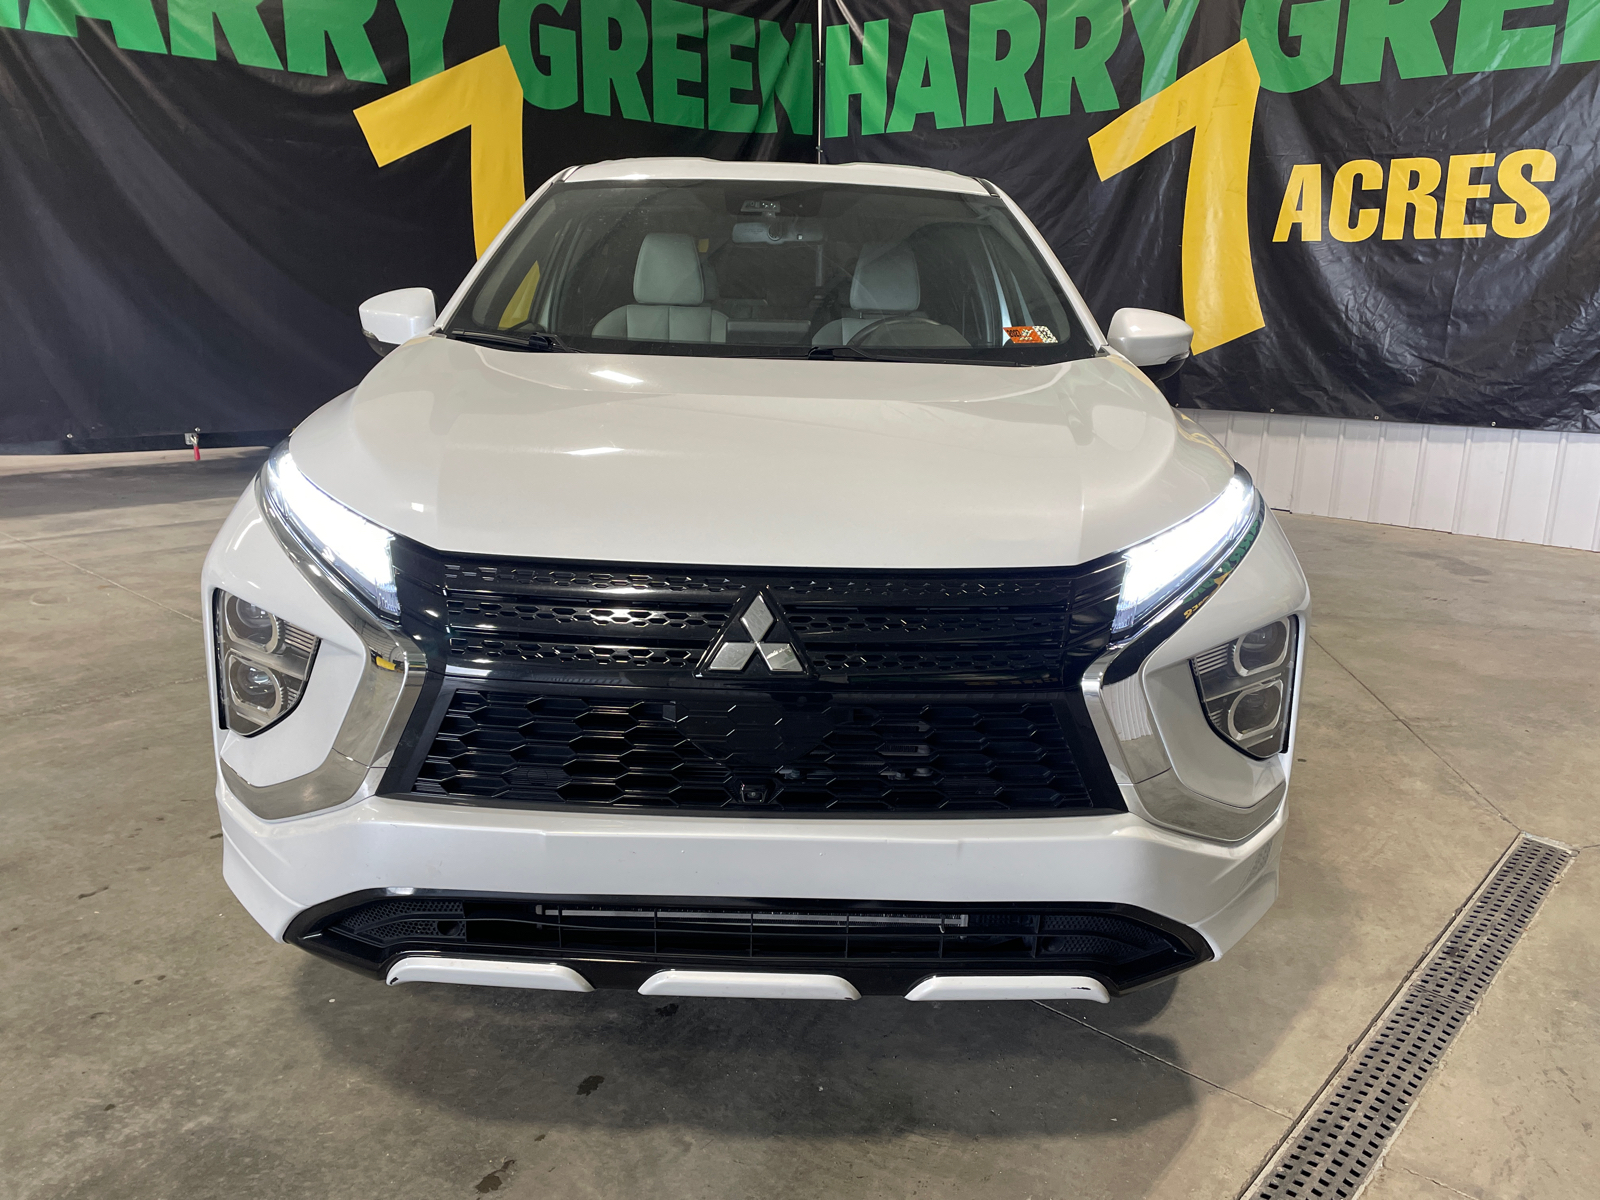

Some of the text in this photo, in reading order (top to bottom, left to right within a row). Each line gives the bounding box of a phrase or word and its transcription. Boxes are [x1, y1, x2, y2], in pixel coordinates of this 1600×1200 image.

[0, 0, 814, 136] ARRY GREEN
[352, 44, 526, 262] 7
[825, 0, 1600, 138] HARRY GRE
[1087, 37, 1557, 356] 7 ACRES
